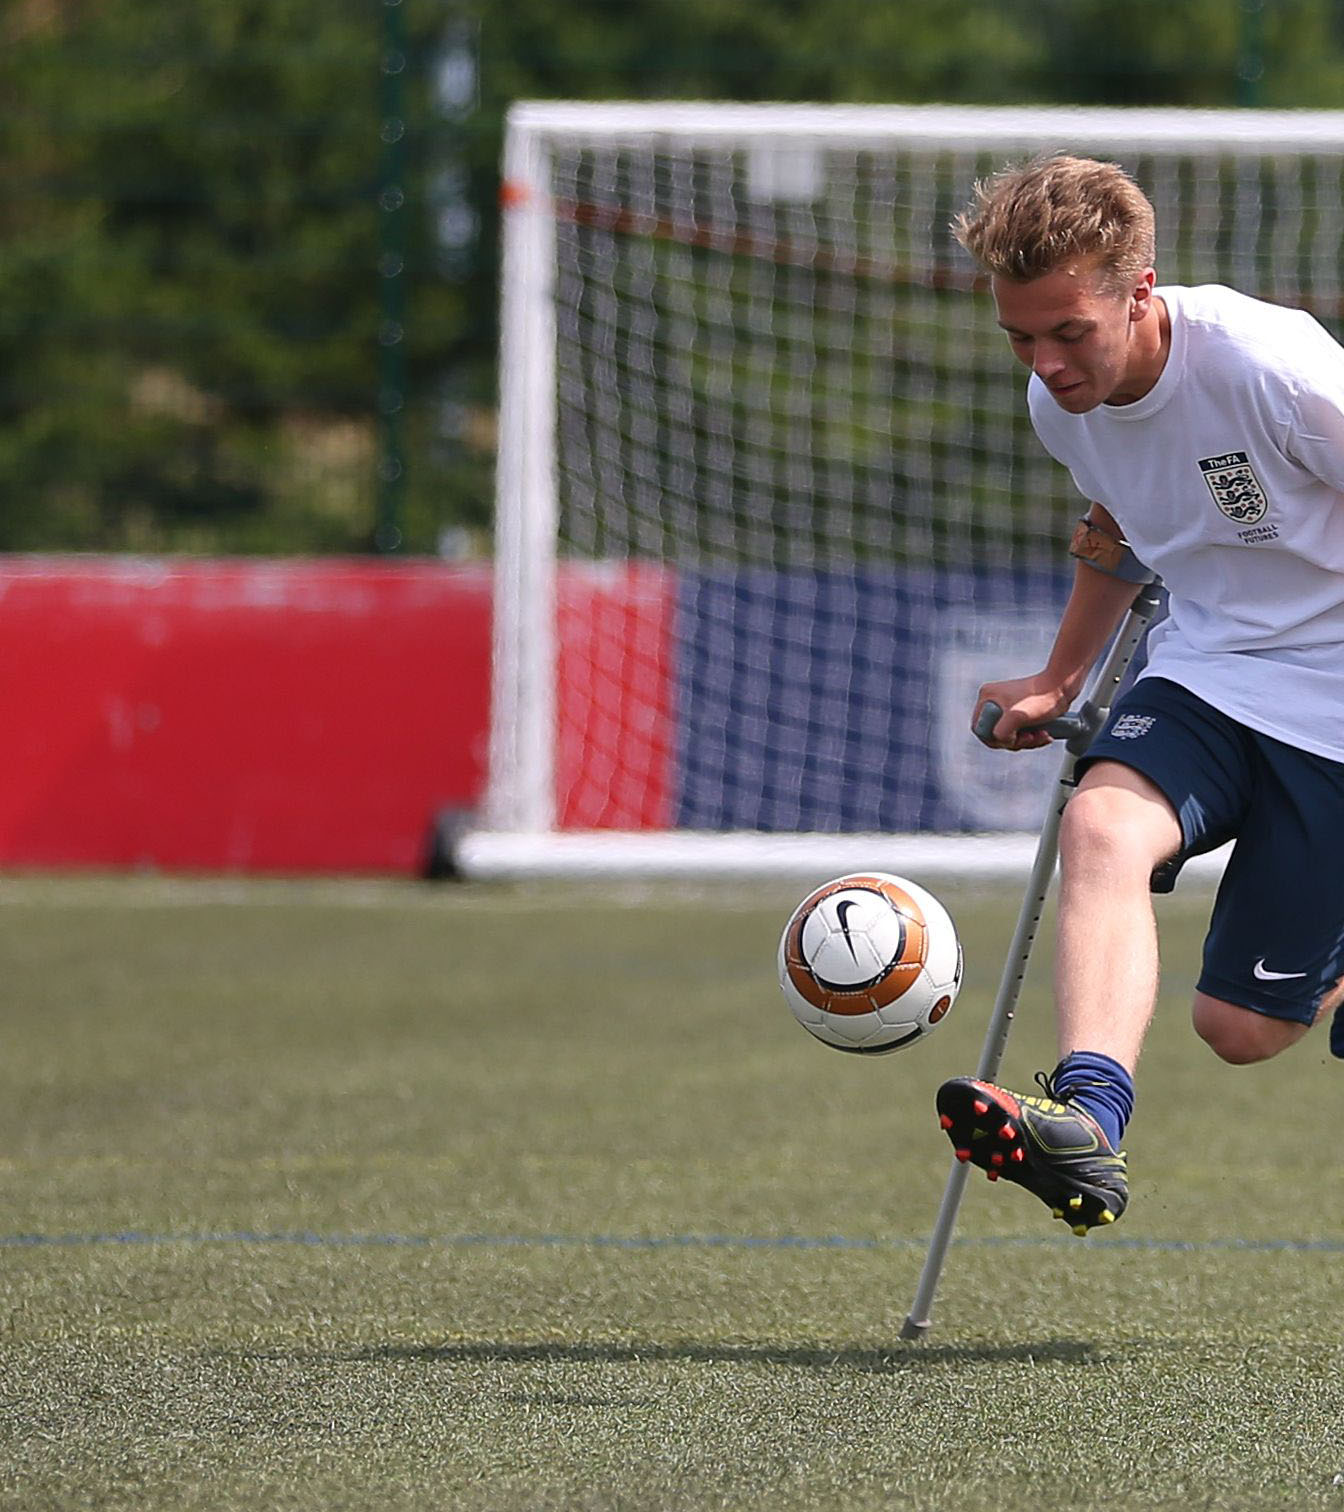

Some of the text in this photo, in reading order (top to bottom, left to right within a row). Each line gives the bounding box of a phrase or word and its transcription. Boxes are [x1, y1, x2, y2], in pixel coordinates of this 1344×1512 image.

[1207, 454, 1241, 468] TheFA
[1237, 524, 1279, 539] FOOTBALL
[1244, 531, 1279, 545] FUTURES
